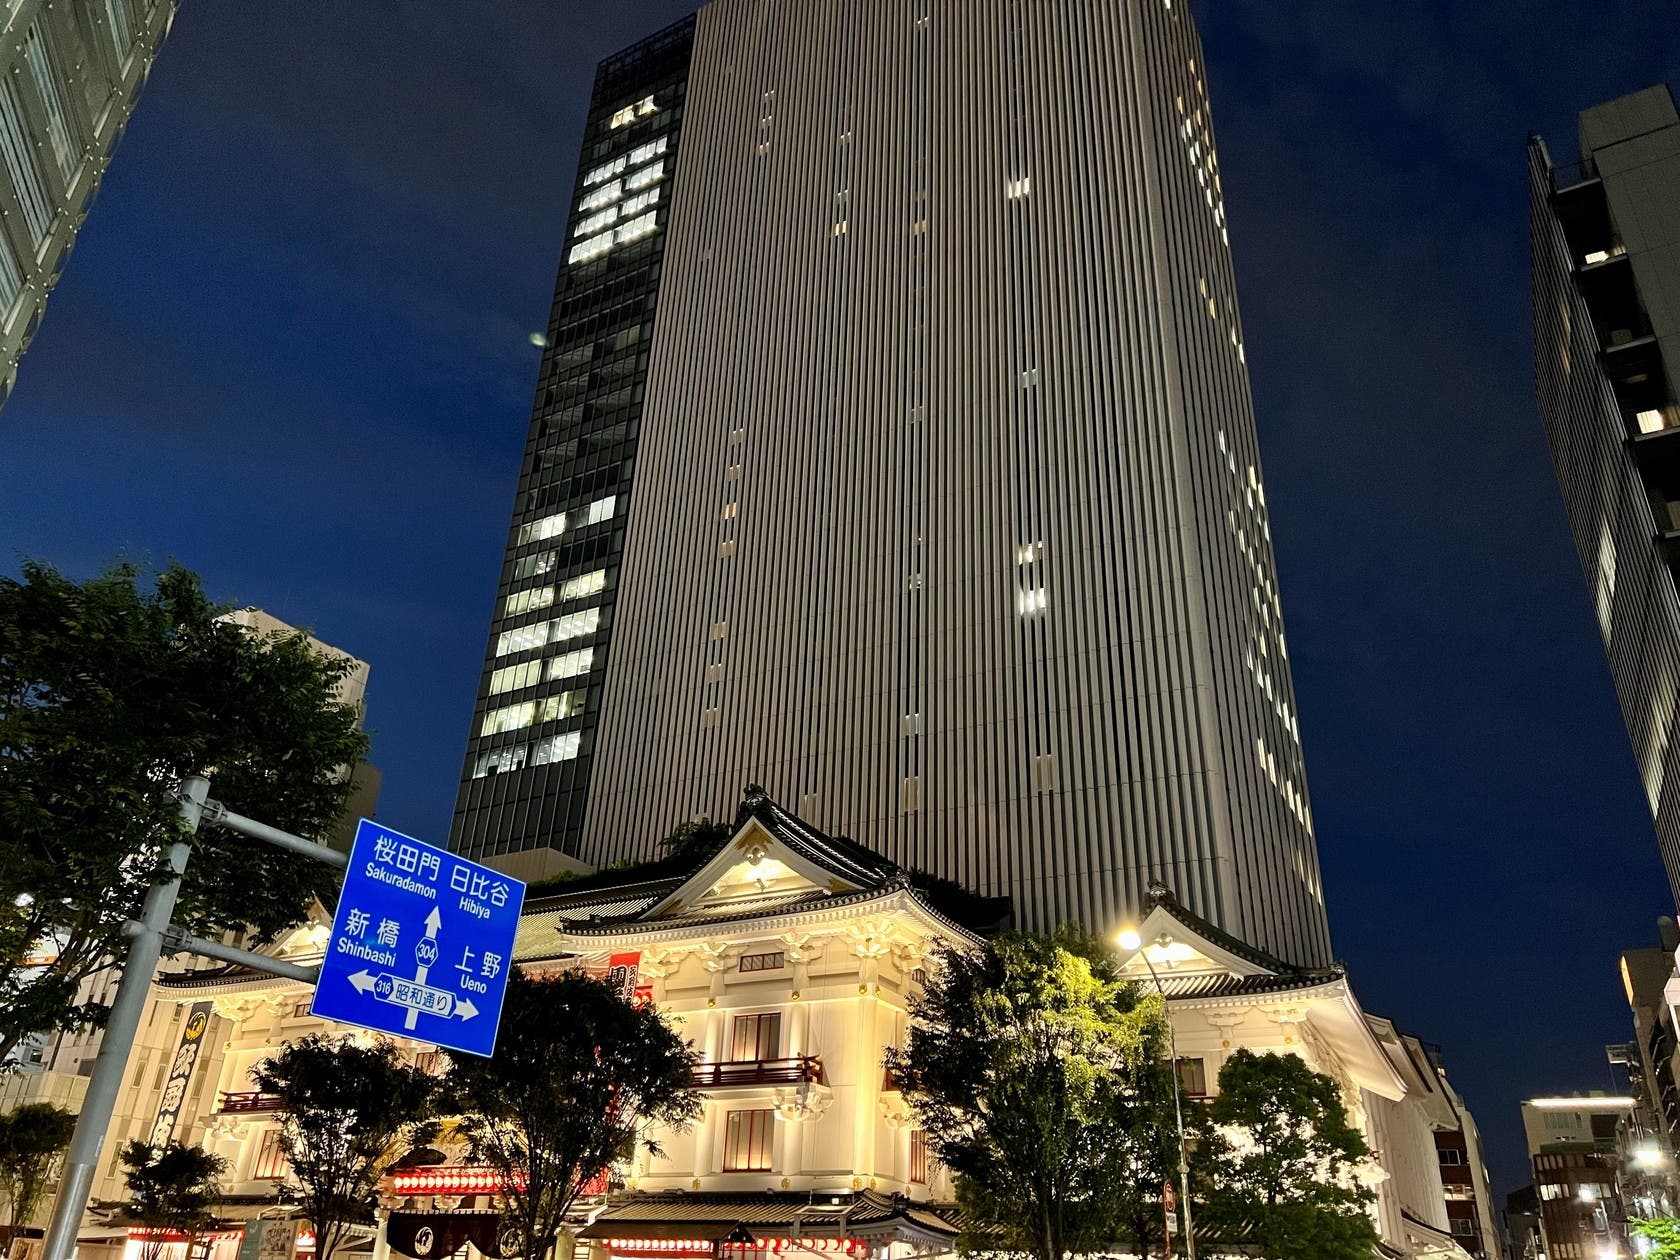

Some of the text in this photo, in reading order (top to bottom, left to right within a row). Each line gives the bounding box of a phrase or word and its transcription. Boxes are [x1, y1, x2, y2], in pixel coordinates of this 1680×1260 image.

[374, 835, 441, 881] 桜田門
[365, 861, 437, 900] Sakuradamon
[450, 864, 510, 907] 日比谷
[459, 896, 491, 919] Hibiya
[344, 908, 401, 949] 新橋
[337, 936, 397, 968] Shinbashi
[417, 943, 436, 961] 304
[454, 945, 502, 979] 上野
[376, 980, 392, 995] 316
[395, 983, 448, 1011] 昭和通り
[460, 973, 487, 994] Ueno
